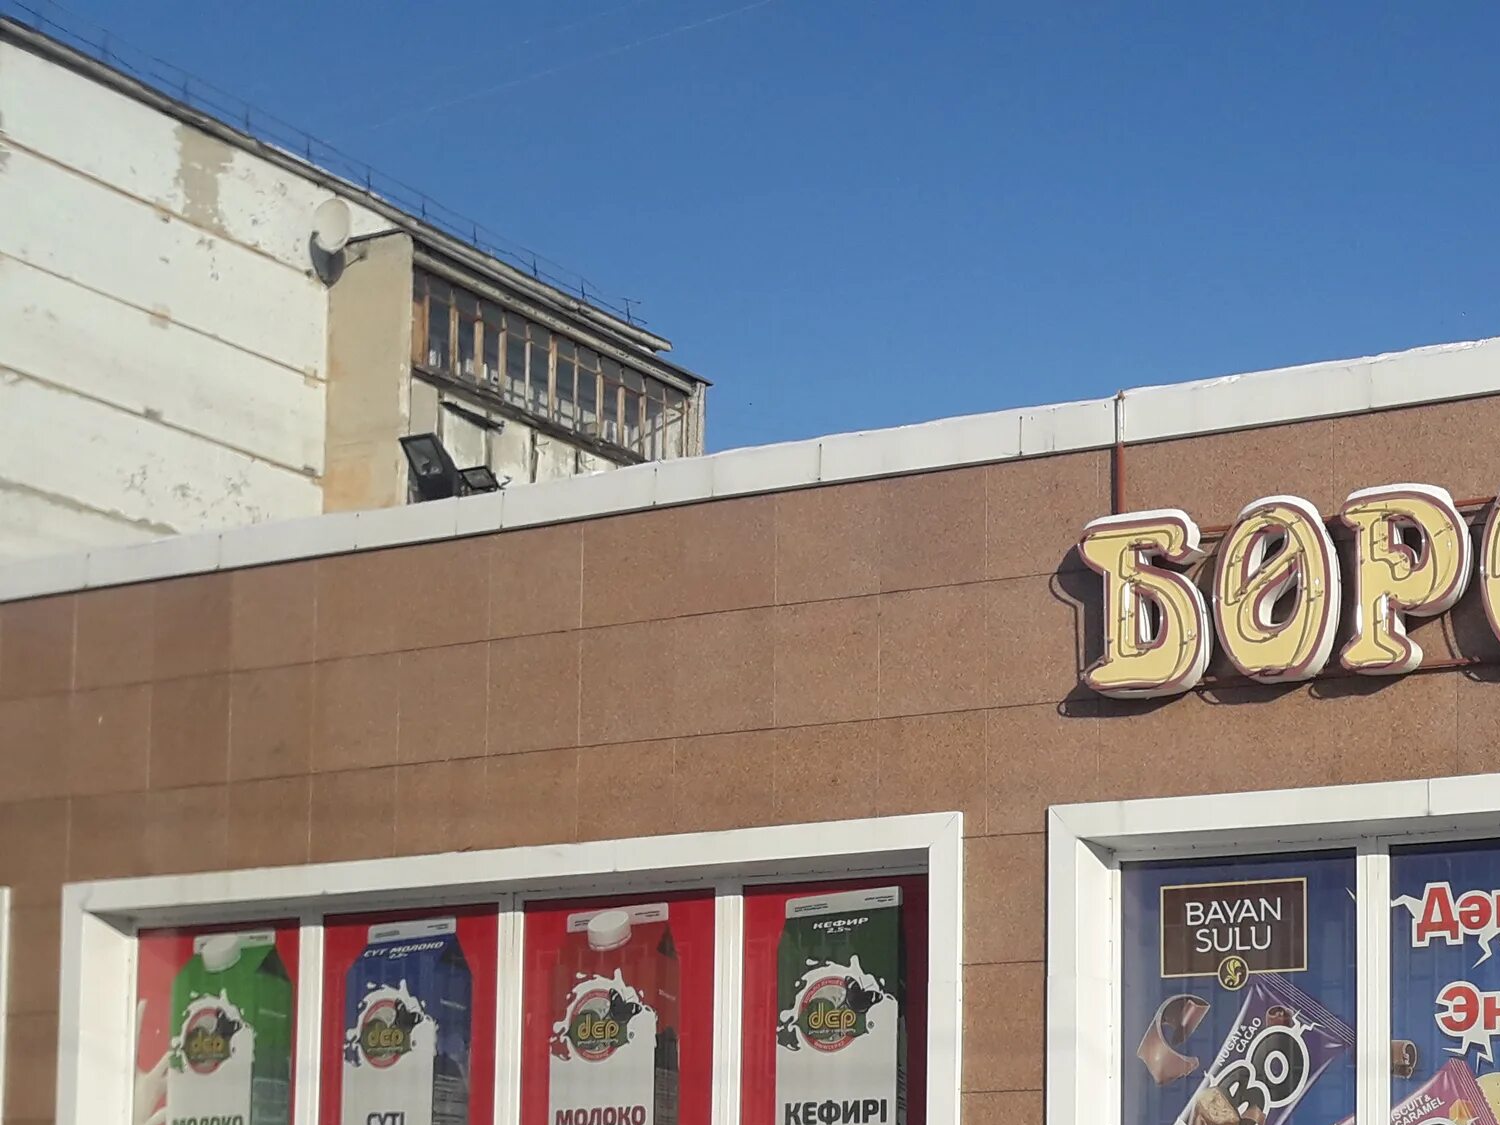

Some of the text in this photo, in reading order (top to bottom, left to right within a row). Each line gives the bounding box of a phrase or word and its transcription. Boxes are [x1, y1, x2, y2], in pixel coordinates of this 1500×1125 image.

[813, 917, 869, 930] КЕФИР
[1186, 897, 1282, 926] BAYAN
[1196, 926, 1271, 953] SULU
[1235, 1017, 1262, 1053] CACAO
